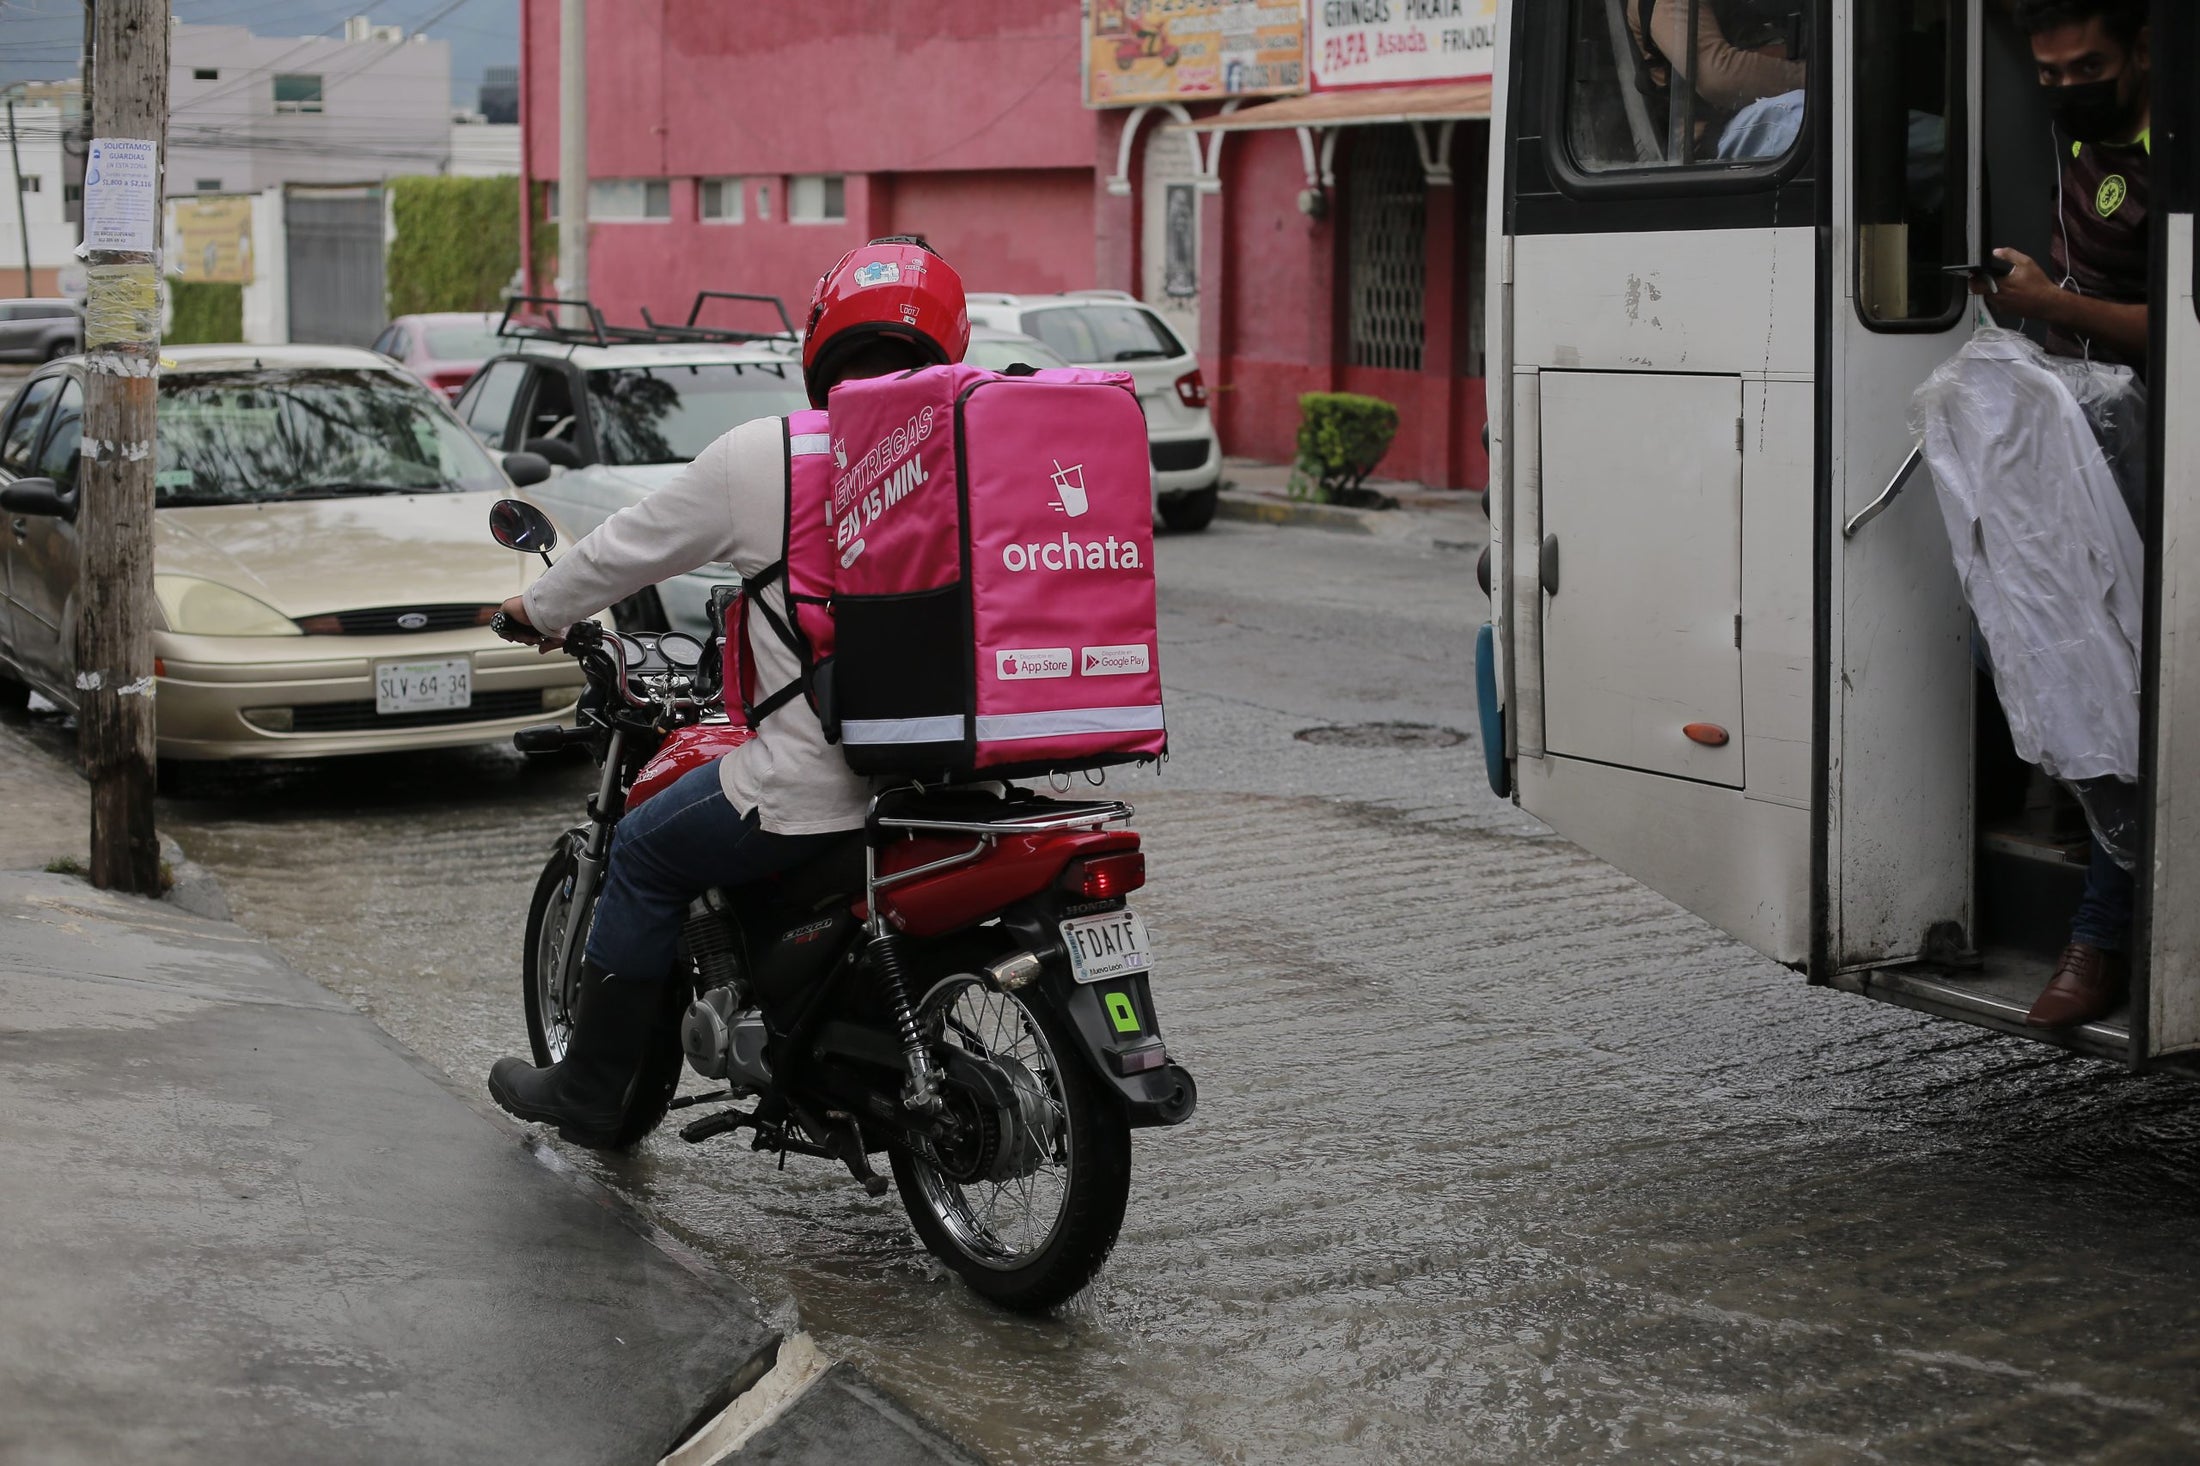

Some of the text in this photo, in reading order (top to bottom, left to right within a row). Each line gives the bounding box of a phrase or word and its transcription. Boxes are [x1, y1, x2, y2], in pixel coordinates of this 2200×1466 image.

[1442, 24, 1495, 53] FRIJOL
[103, 142, 152, 151] SOLICITAMOS
[109, 152, 145, 161] GUARDIAS
[834, 406, 933, 514] ENTREGAS
[837, 453, 929, 550] EN 15 MIN.
[1021, 659, 1068, 673] App Store
[1102, 655, 1146, 668] Google Play
[1075, 921, 1135, 959] FDA7F
[1089, 966, 1108, 976] Nuevo
